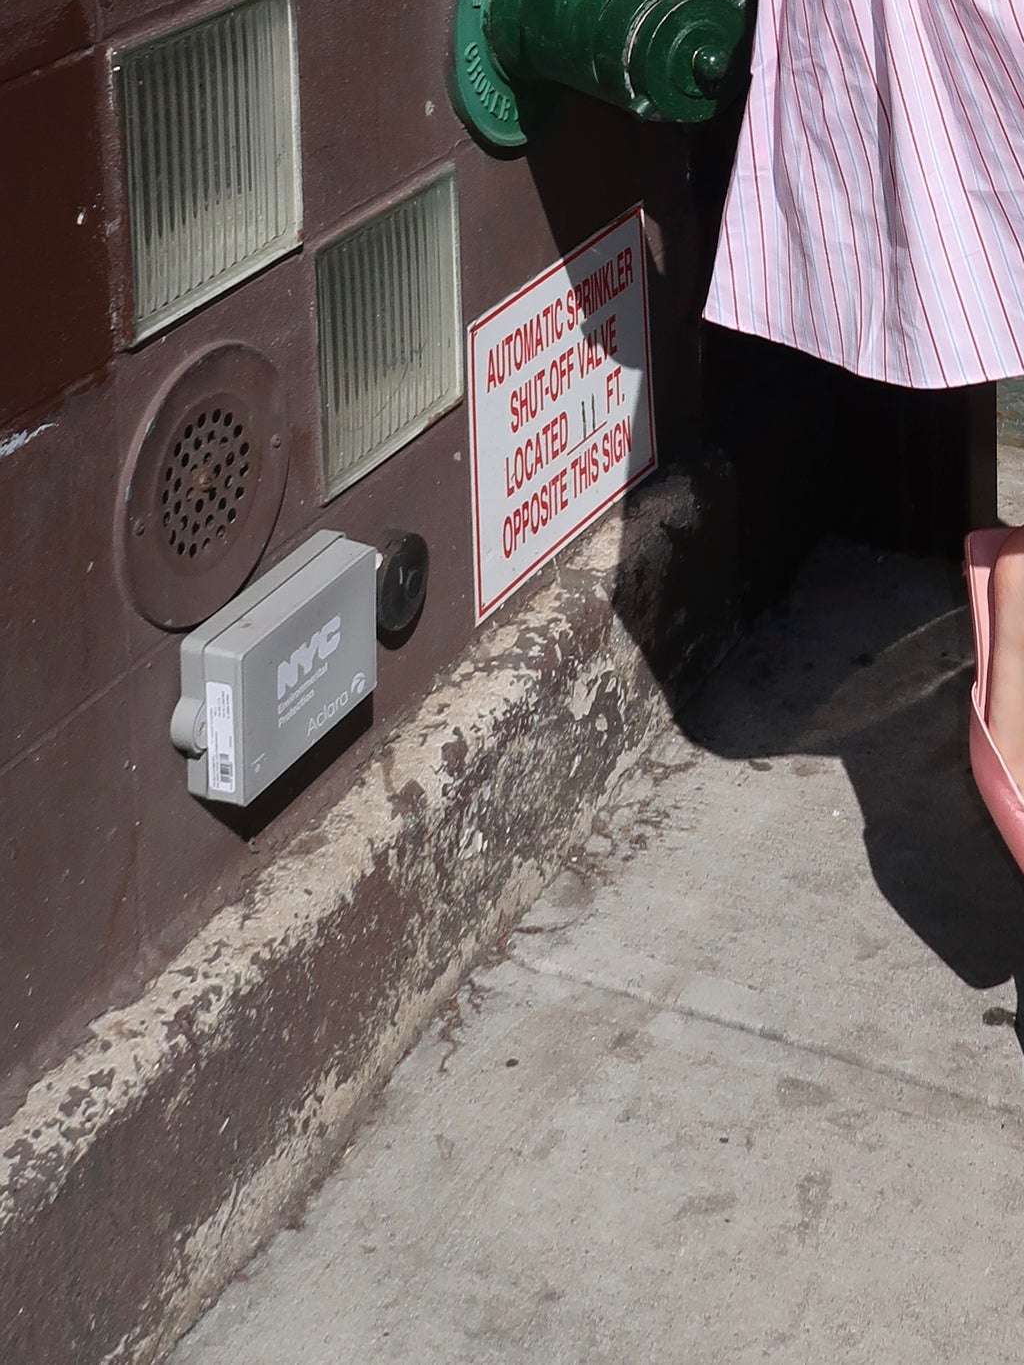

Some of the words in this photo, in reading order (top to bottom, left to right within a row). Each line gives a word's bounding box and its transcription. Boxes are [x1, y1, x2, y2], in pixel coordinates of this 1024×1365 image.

[487, 297, 563, 394] AUTOMATIC
[566, 247, 634, 331] SPRINKLER
[510, 348, 574, 434] SHUT-OFF
[576, 314, 617, 379] VALVE
[503, 469, 567, 560] OPPOSITE
[571, 442, 600, 494] THIS
[603, 415, 632, 475] SIGN
[505, 410, 568, 498] LOCATED
[606, 366, 625, 414] FT.
[277, 615, 341, 701] NYC
[307, 691, 349, 736] Aclara
